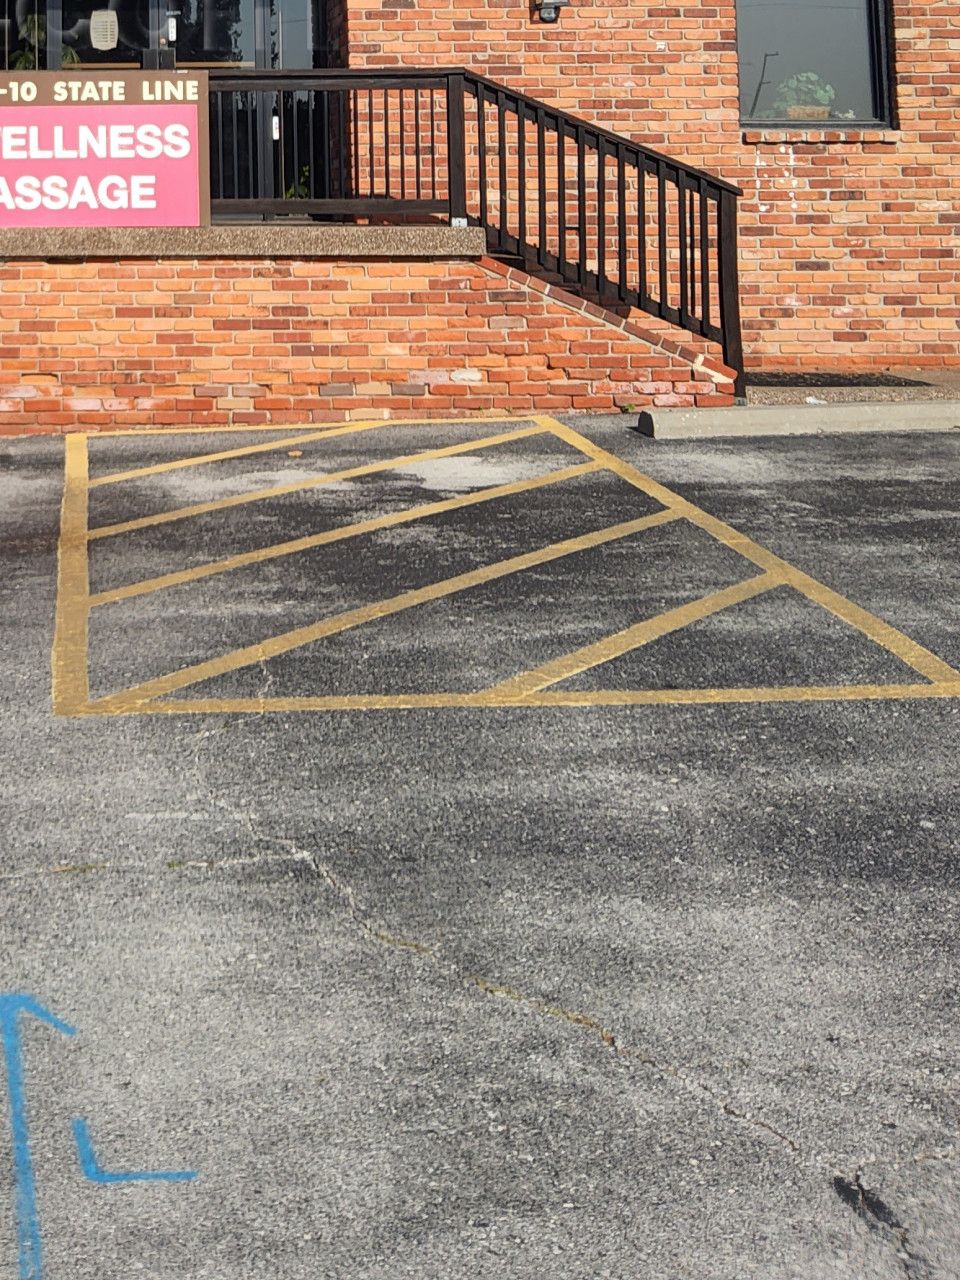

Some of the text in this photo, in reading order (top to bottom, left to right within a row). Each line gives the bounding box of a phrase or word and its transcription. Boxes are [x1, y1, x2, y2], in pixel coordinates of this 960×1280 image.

[53, 80, 126, 102] STATE
[142, 80, 199, 101] LINE
[72, 1116, 199, 1185] L
